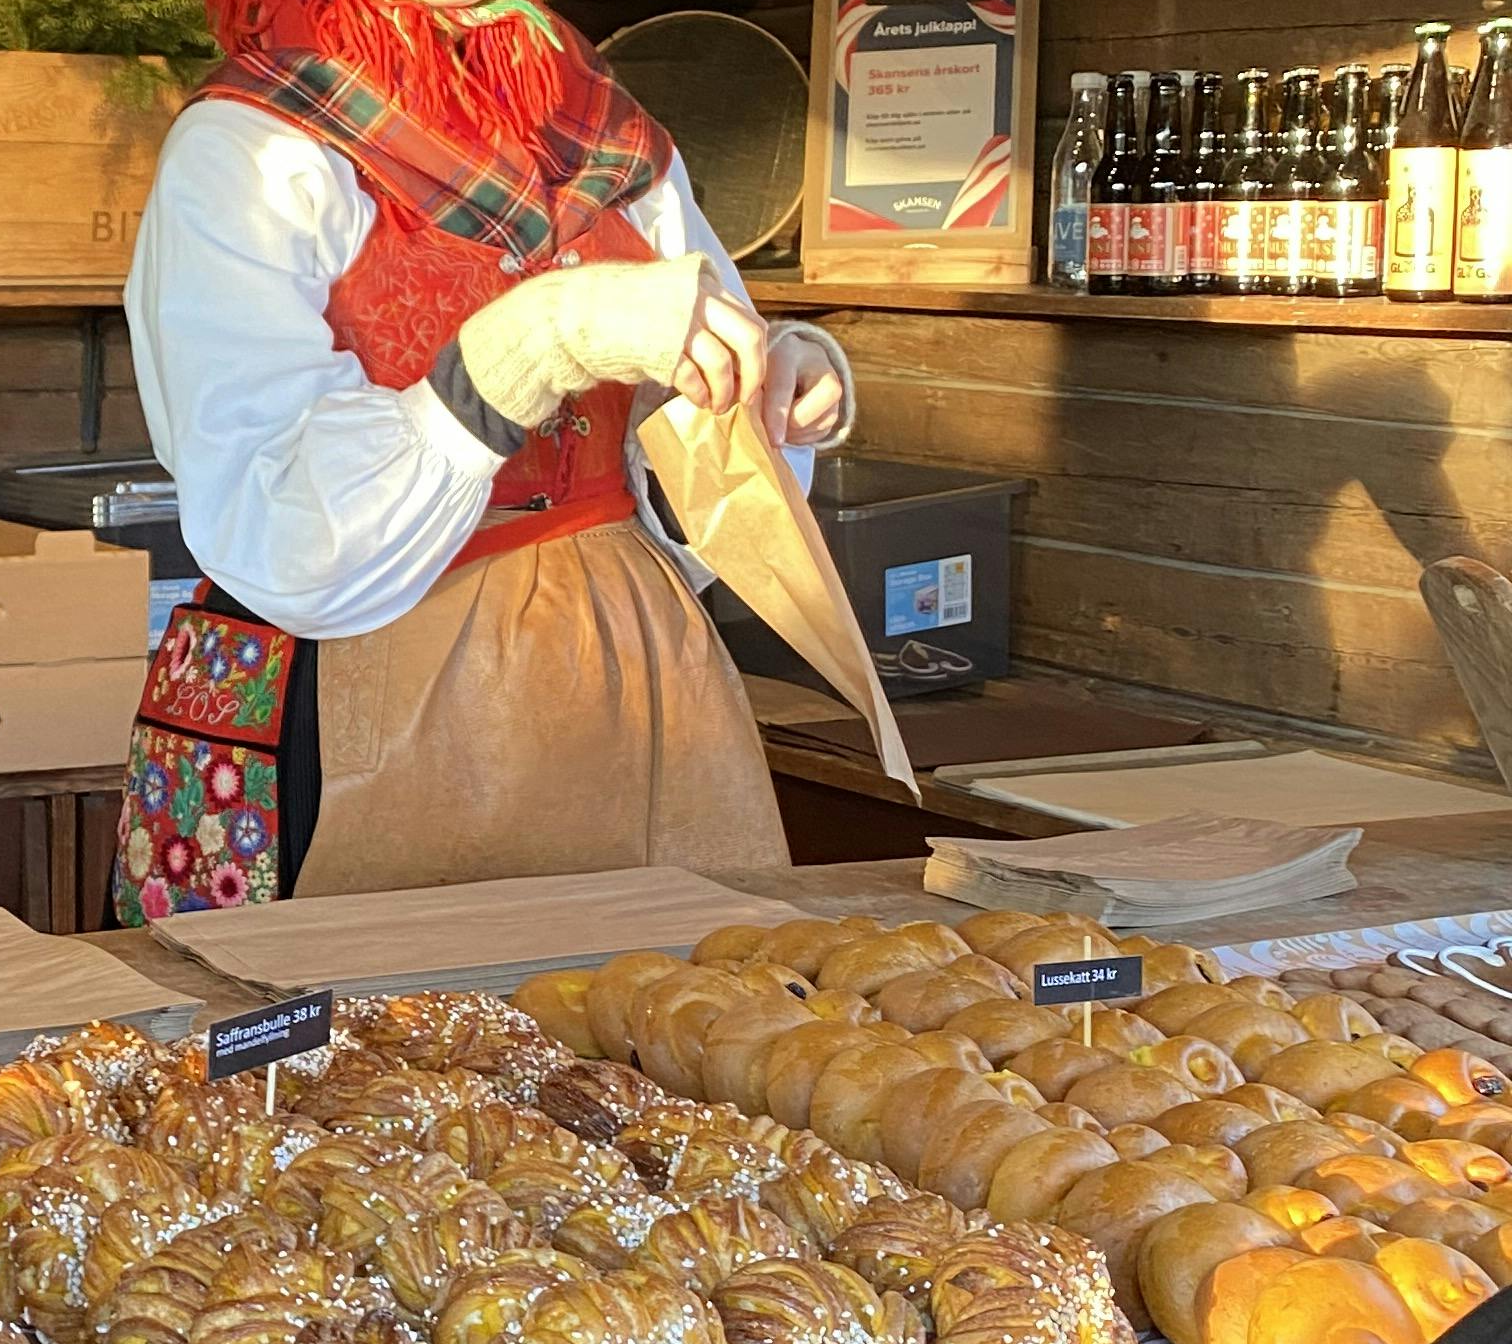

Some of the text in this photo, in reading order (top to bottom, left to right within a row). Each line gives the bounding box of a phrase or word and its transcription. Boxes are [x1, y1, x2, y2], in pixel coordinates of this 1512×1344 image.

[873, 18, 977, 37] Årets julklapp!
[868, 63, 981, 80] Skansens årskort
[867, 83, 911, 96] 365 kr
[892, 196, 942, 212] SKANSEN
[1040, 967, 1118, 987] Lussekatt 34 kr
[215, 1004, 322, 1047] Saffransbulle 38 kr
[215, 1044, 235, 1058] med
